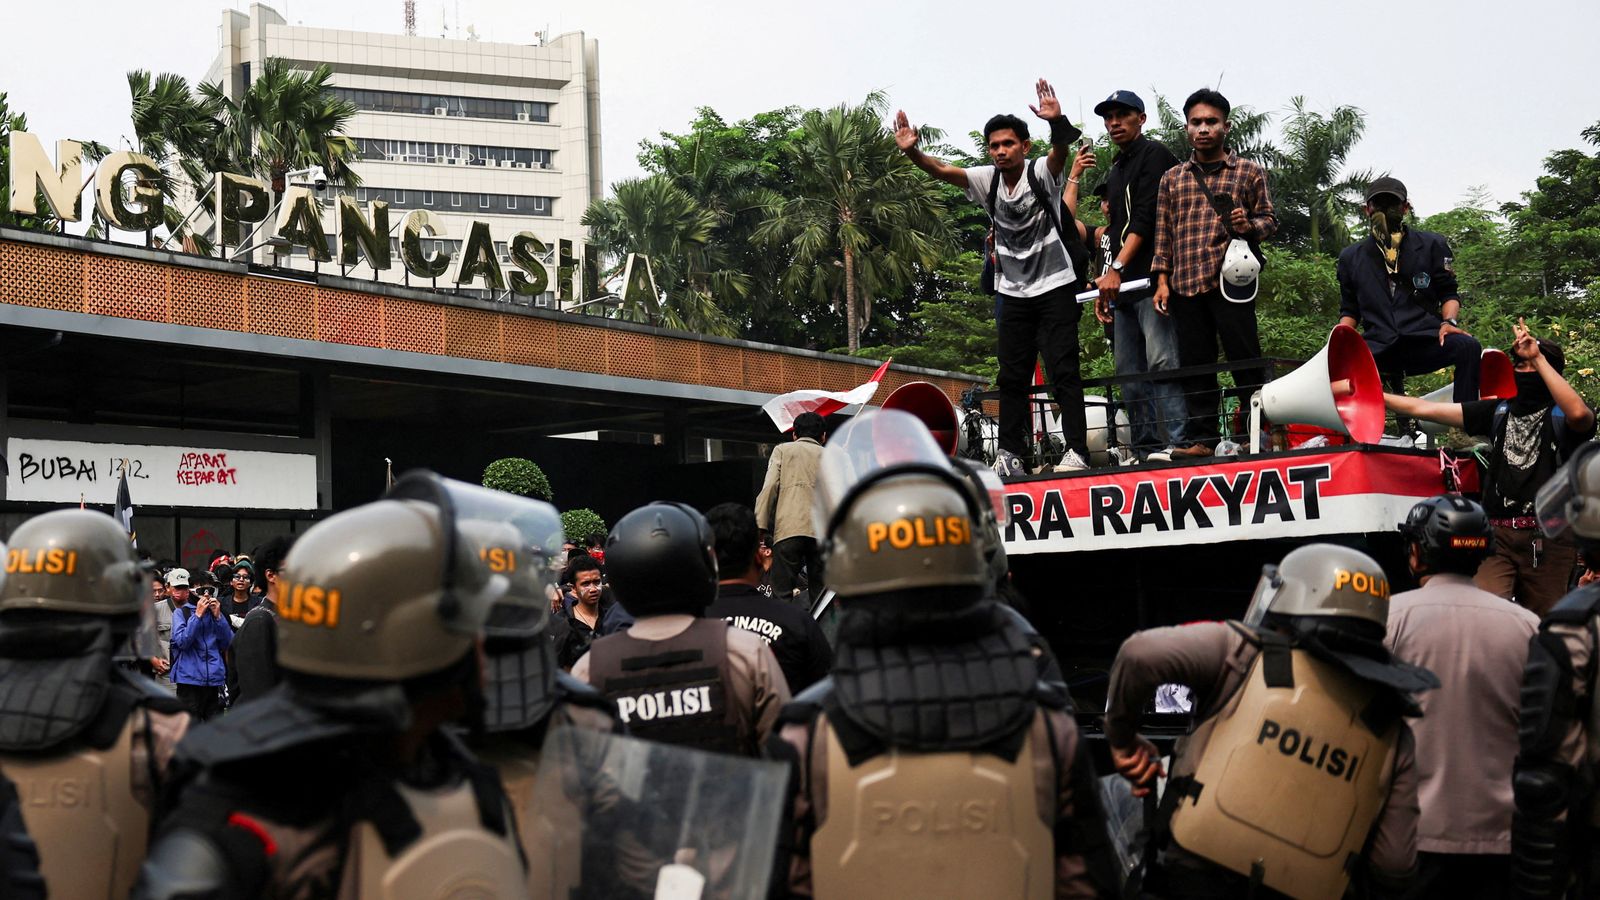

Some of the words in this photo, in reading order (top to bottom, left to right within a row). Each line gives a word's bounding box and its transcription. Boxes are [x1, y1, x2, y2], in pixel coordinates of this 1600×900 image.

[9, 130, 164, 232] NG
[215, 171, 662, 313] PANCASILA
[180, 452, 228, 470] APARAT
[1089, 464, 1331, 537] RAKYAT
[867, 516, 971, 552] POLISI
[617, 685, 712, 723] POLISI
[1257, 718, 1359, 782] POLISI
[872, 799, 999, 838] POLISI
